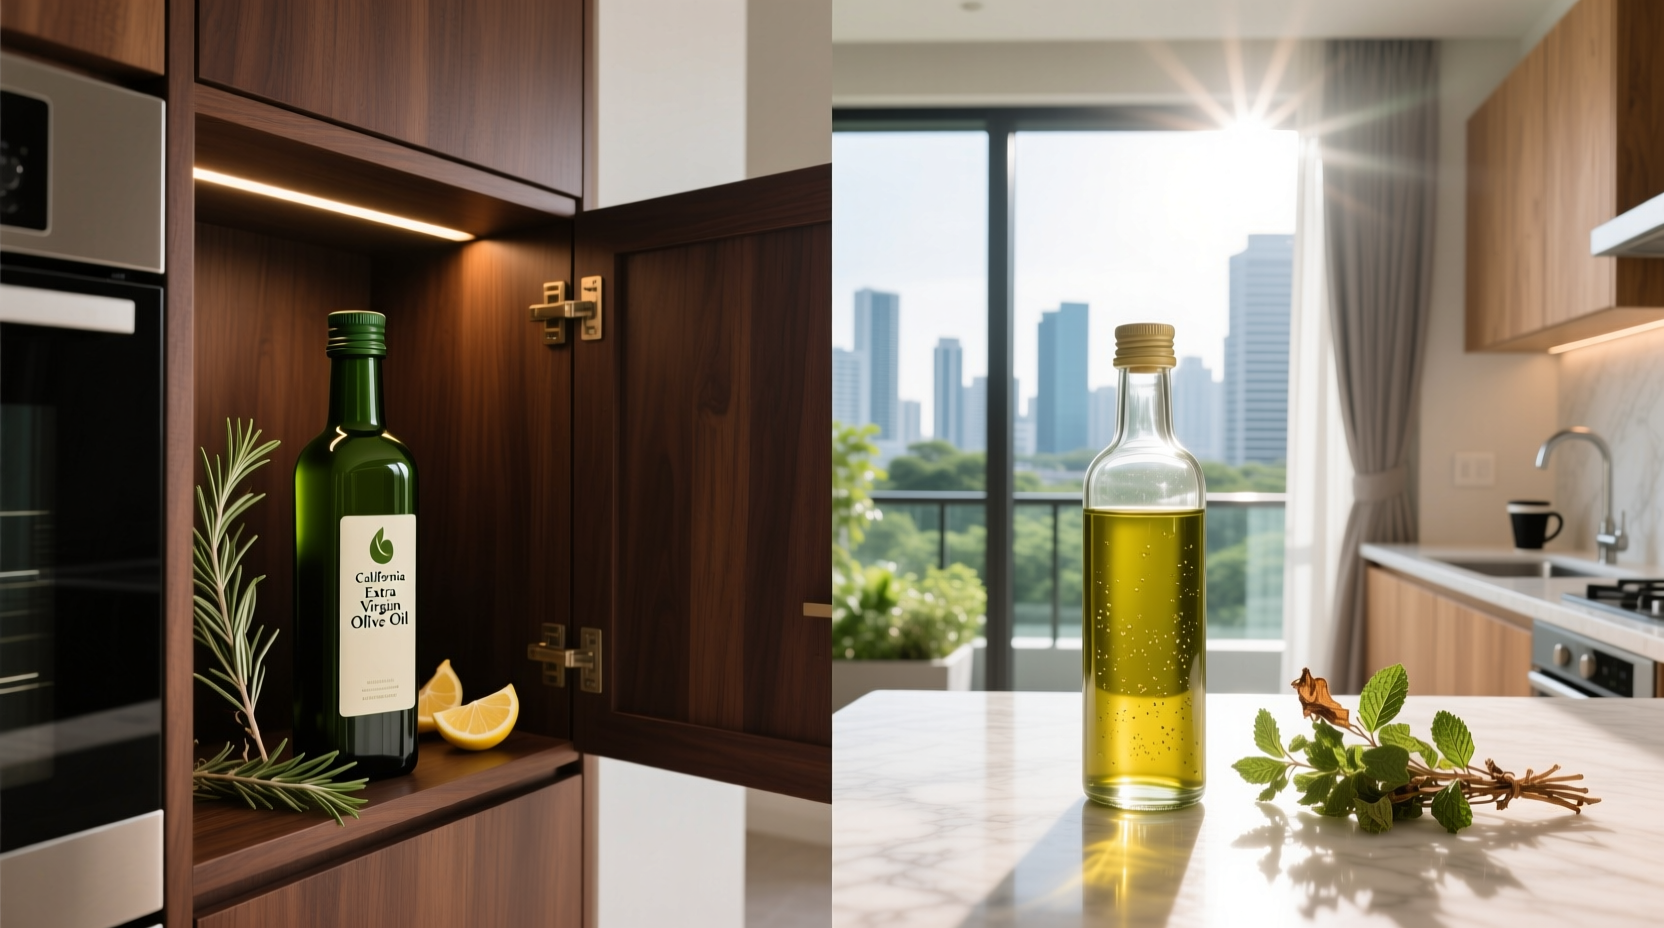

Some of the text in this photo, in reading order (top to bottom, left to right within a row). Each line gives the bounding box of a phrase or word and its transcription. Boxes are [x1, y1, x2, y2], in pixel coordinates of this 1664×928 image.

[365, 586, 396, 598] Extra
[351, 611, 408, 629] Olive Oil
